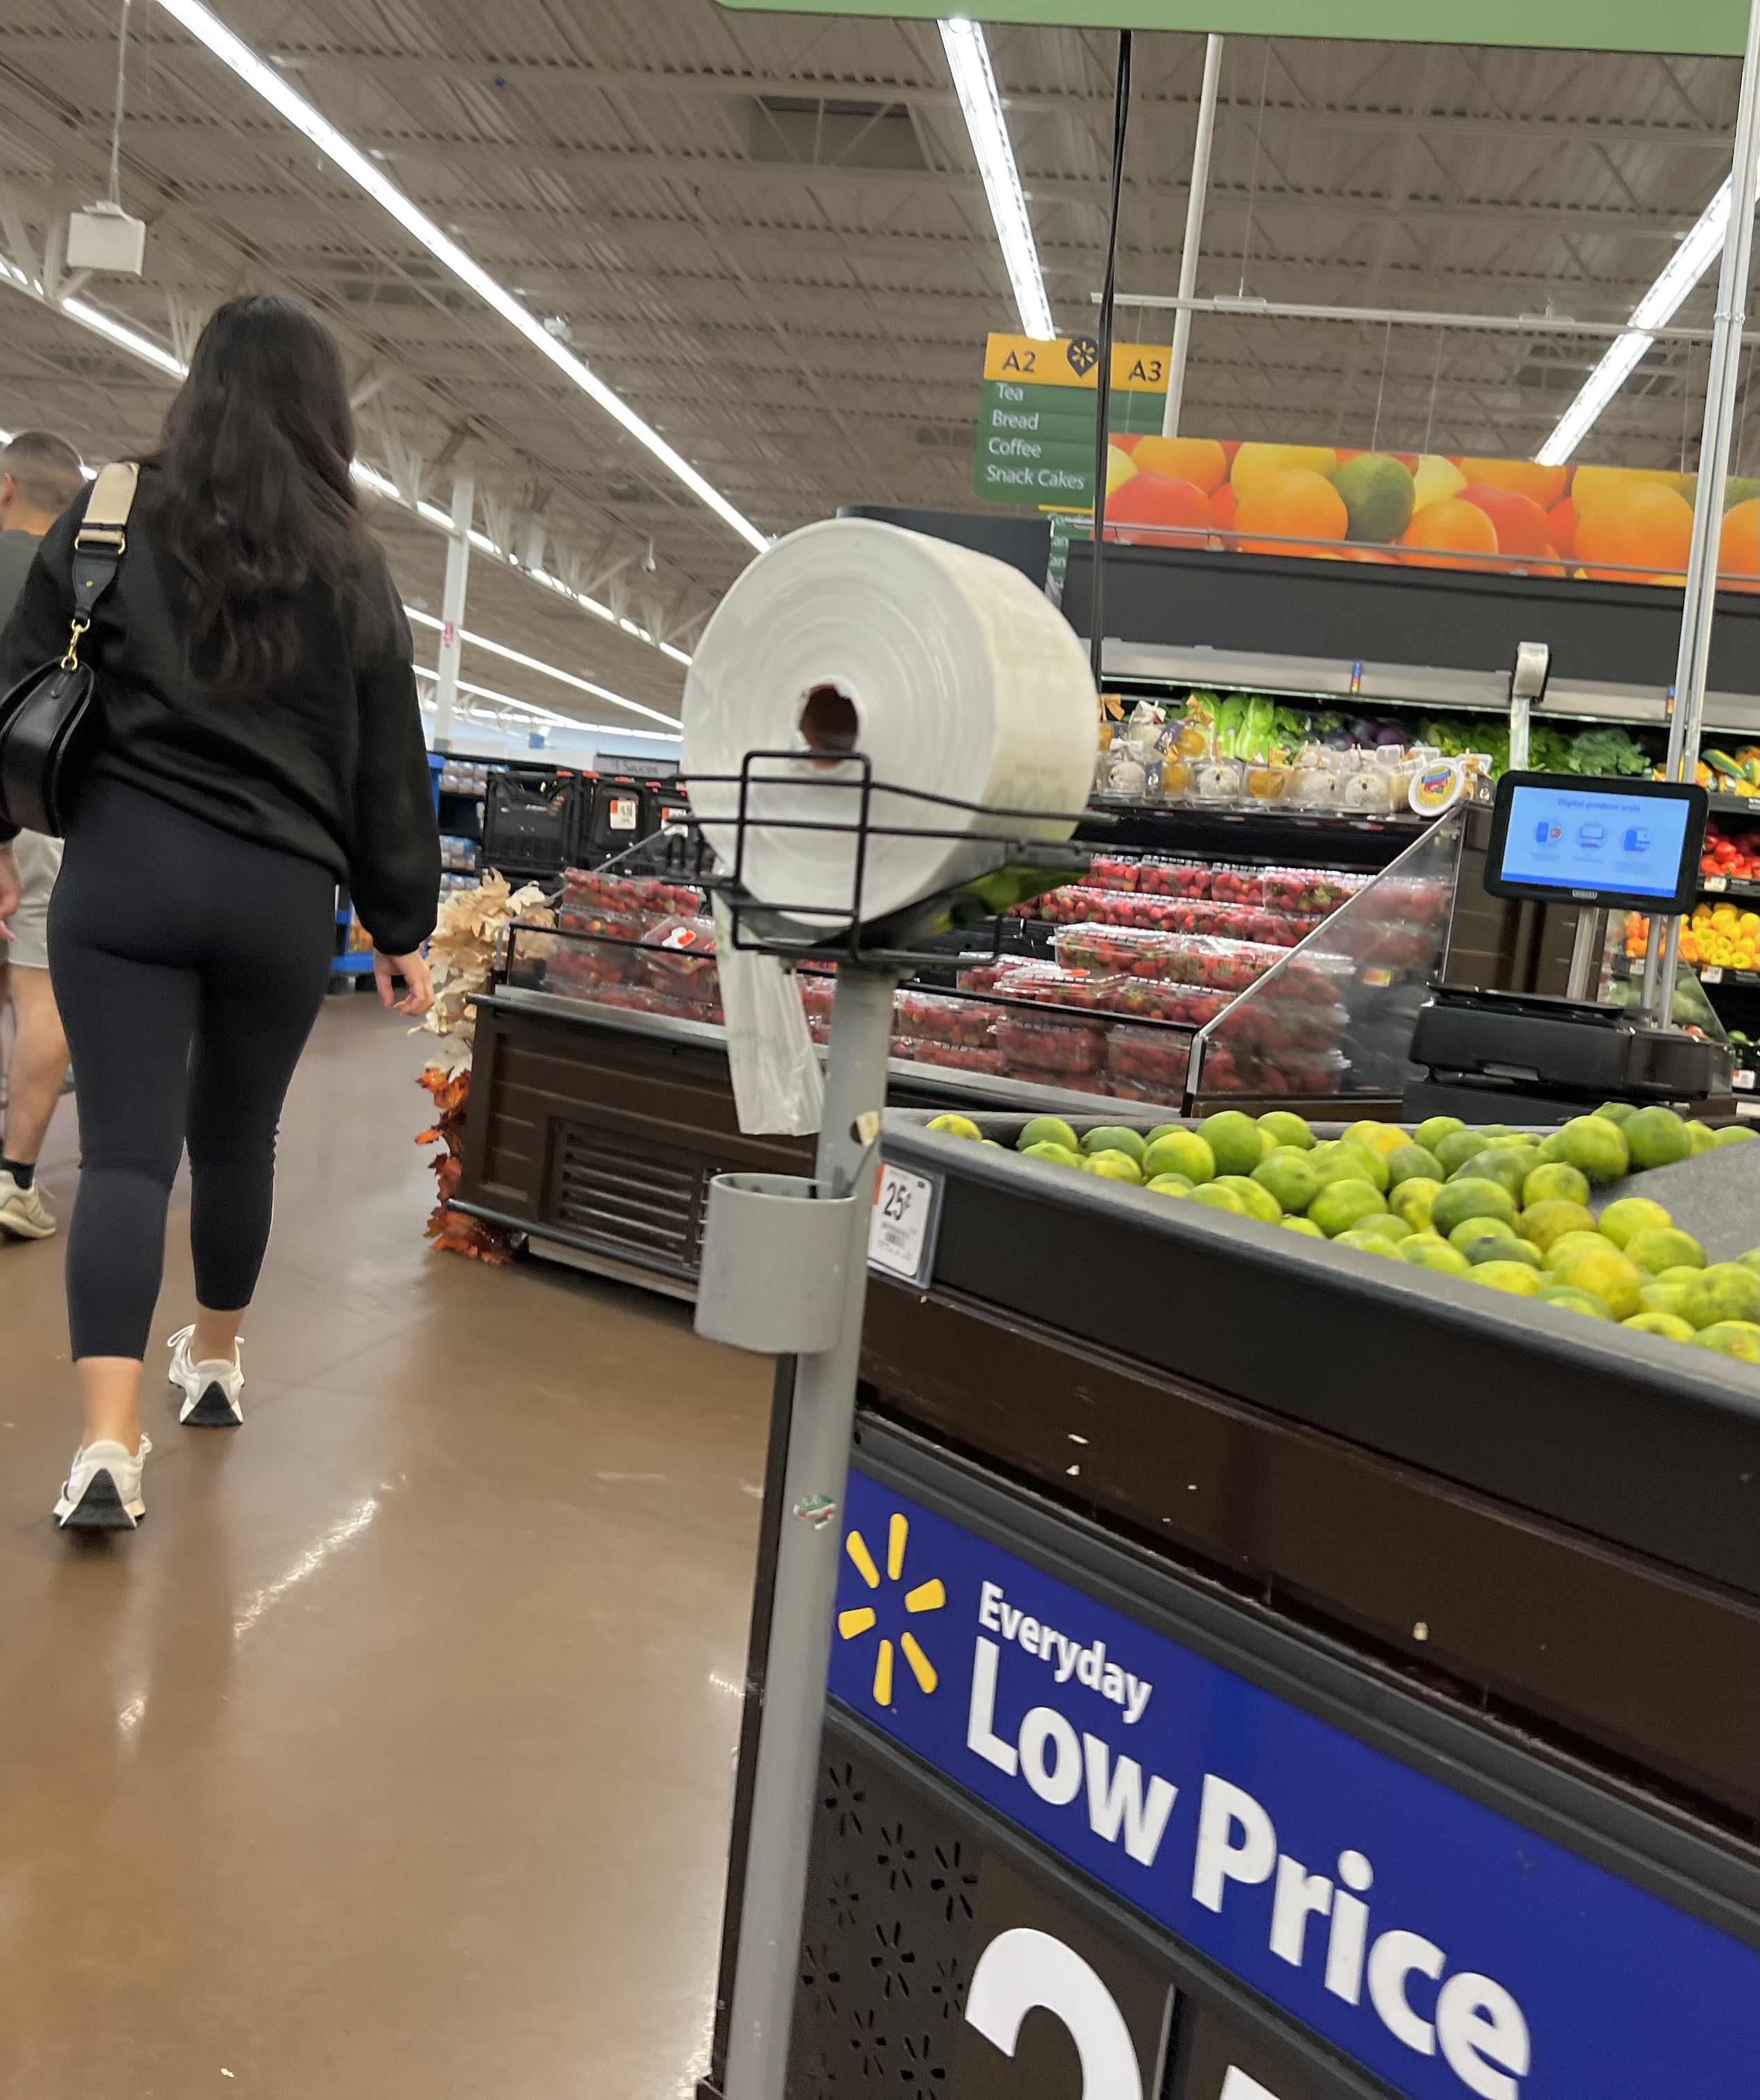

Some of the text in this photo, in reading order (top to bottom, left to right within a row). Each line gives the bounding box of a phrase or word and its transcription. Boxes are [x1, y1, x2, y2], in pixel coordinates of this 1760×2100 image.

[1002, 350, 1036, 373] A2
[1128, 360, 1162, 382] A3
[996, 382, 1024, 401] Tea
[992, 409, 1039, 430] Bread
[989, 437, 1042, 458] Coffee
[987, 464, 1084, 490] Snack Cakes
[978, 1580, 1153, 1724] Everyday
[966, 1635, 1532, 2100] Low Price
